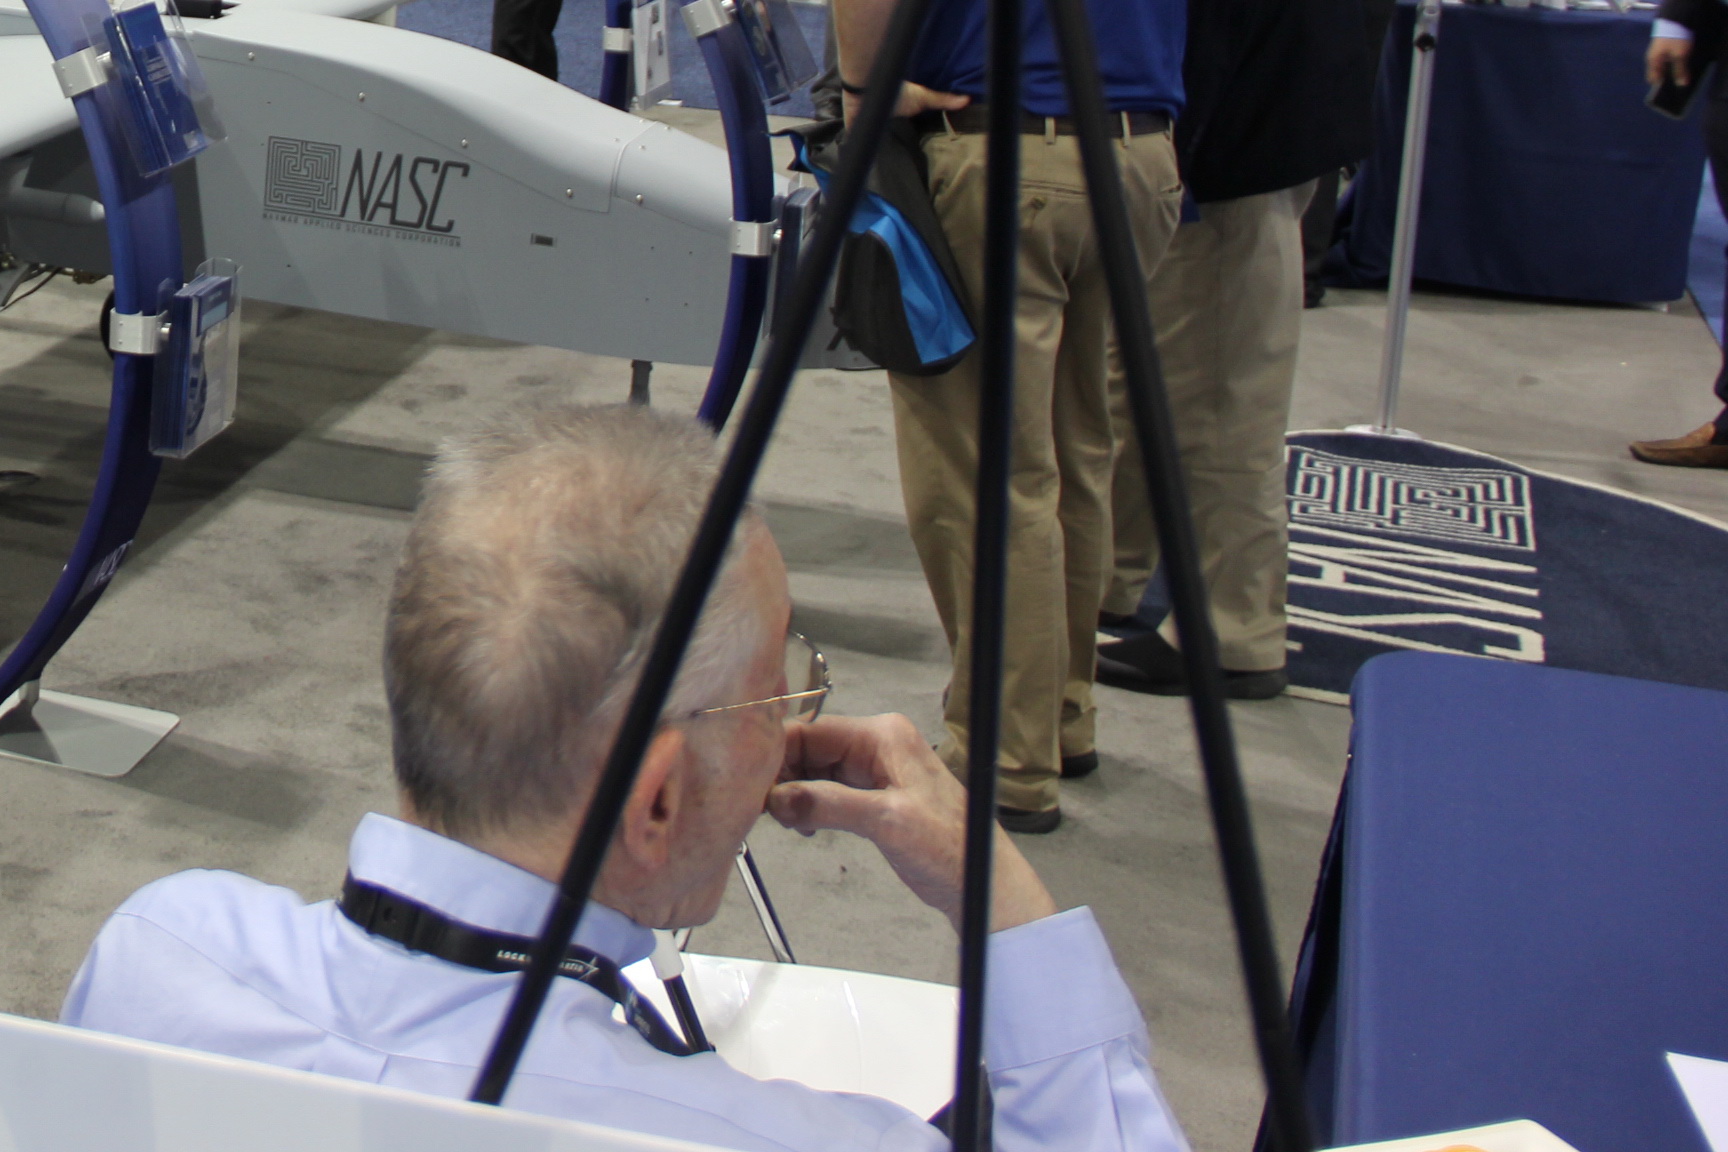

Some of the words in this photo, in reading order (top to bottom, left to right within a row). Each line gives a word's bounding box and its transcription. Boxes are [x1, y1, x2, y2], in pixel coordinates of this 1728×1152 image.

[338, 147, 471, 233] NASC
[303, 217, 342, 231] APPLIED
[345, 223, 391, 239] SCIENCES
[395, 231, 462, 248] CORPORATION
